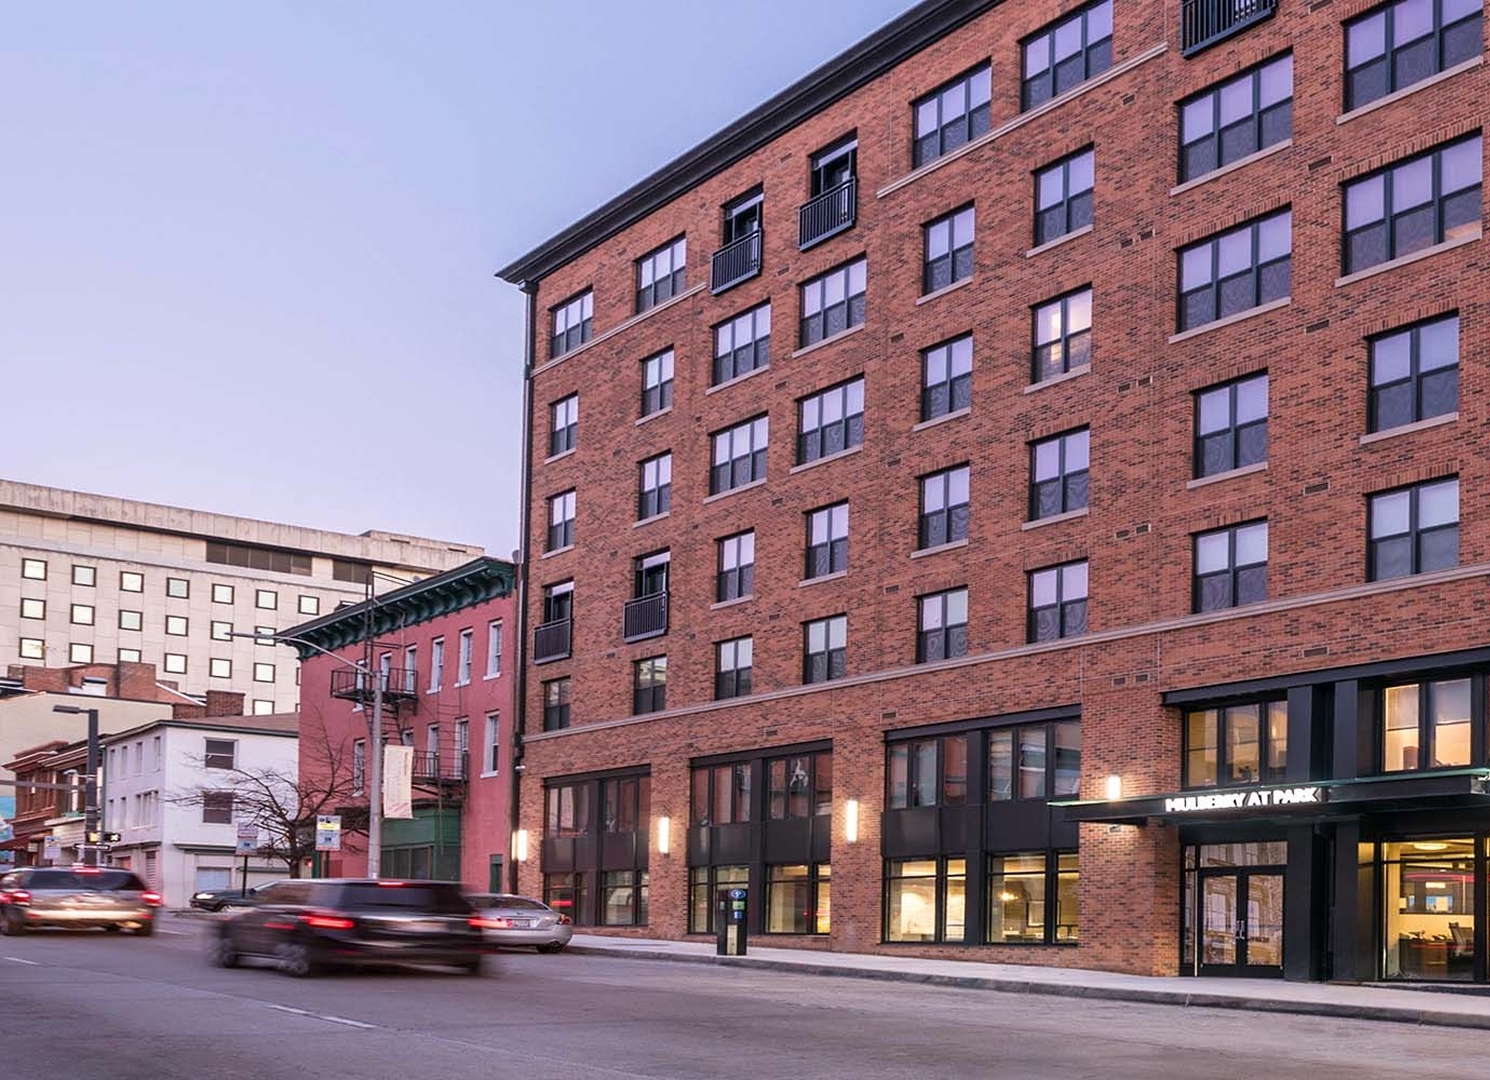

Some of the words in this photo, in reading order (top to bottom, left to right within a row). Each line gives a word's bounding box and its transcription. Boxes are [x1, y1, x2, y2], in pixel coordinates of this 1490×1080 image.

[1165, 793, 1246, 812] MULBERRY
[1247, 791, 1271, 806] AT
[1273, 787, 1318, 805] PARK
